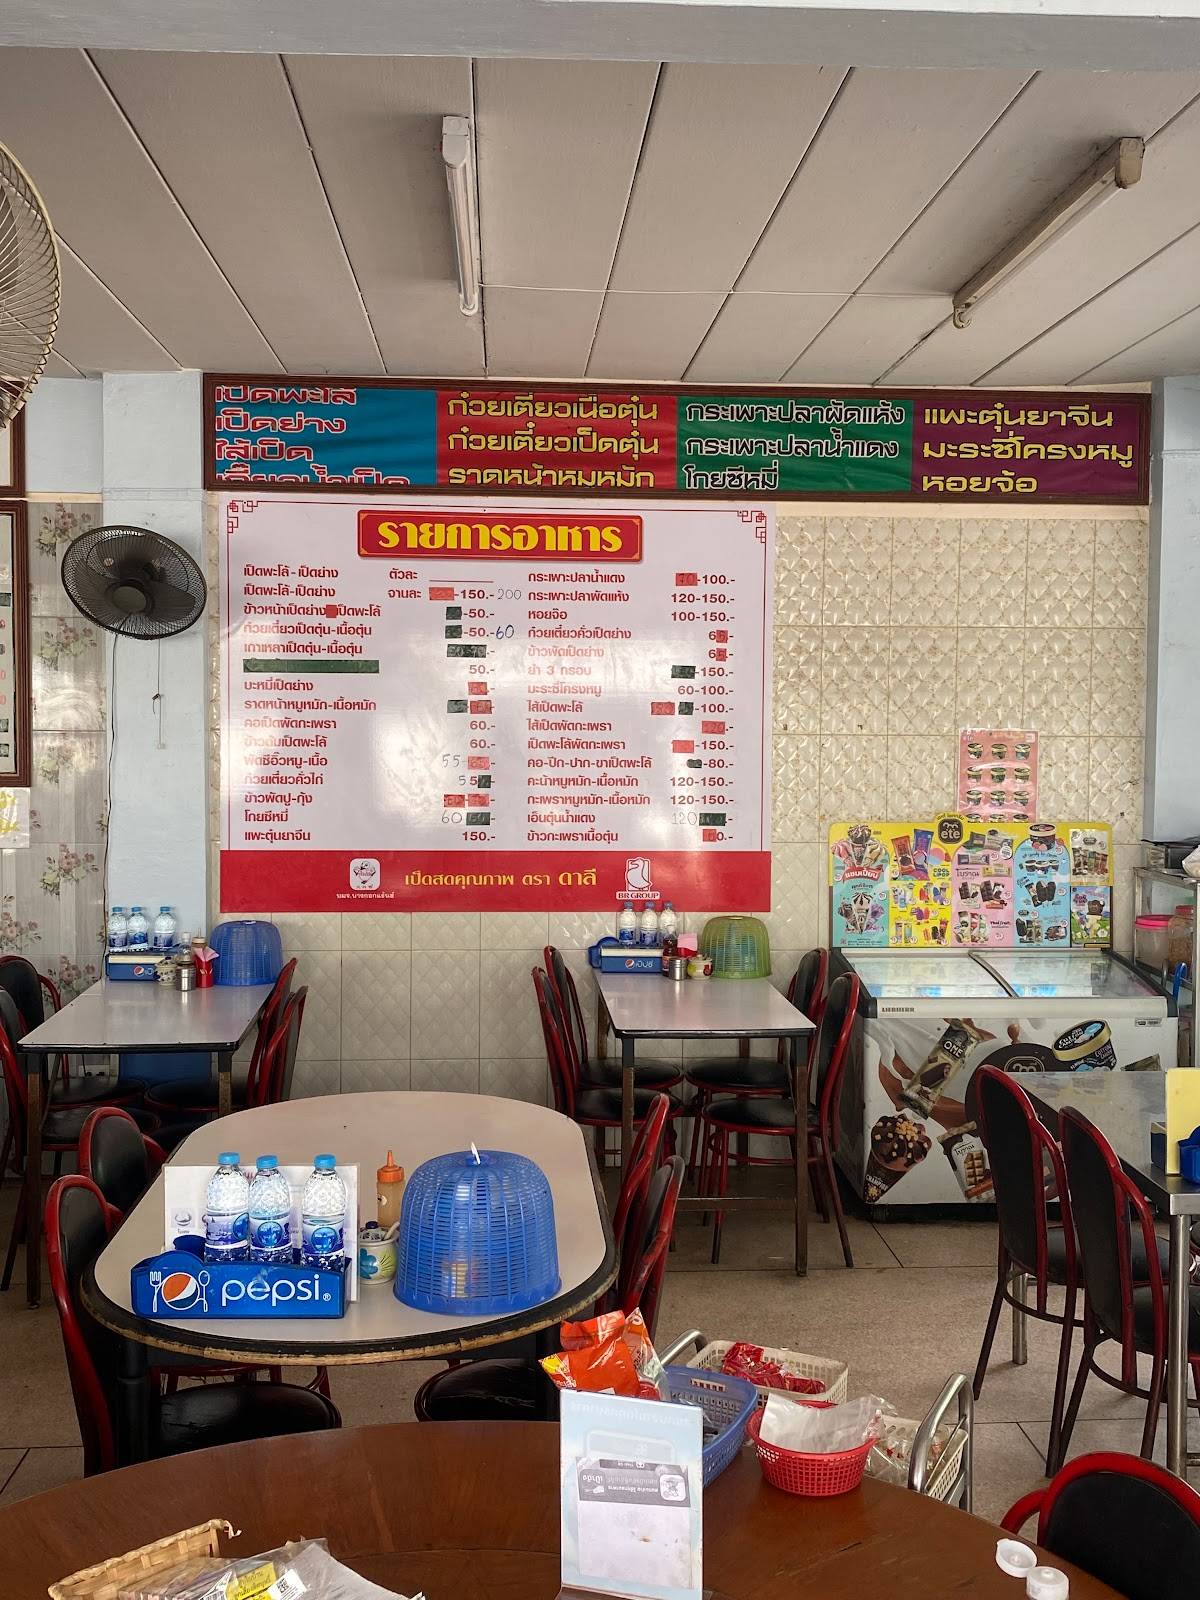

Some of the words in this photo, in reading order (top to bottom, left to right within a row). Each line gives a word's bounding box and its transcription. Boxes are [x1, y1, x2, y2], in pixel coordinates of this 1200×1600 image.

[686, 400, 906, 424] กระเพาะปลาผัดแห้ง
[924, 402, 1114, 433] แพะตุ๋นยาจีน
[216, 408, 347, 433] เป็ดย่าง
[447, 421, 660, 462] ก๋วยเตี๋ยวเป็ดตุ๋น
[686, 427, 900, 458] กระเพาะปลาน้ำแดง
[683, 460, 779, 490] โกยซีหมี่
[922, 469, 1038, 493] หอยจ้อ
[378, 520, 623, 553] รายการอาหาร
[389, 567, 418, 580] ตัวละ
[387, 588, 422, 600] จานละ
[671, 592, 735, 603] 120-150.-
[671, 611, 735, 622] 100-150.-
[469, 664, 495, 675] 50.-
[678, 685, 734, 695] 60-100.-
[470, 720, 496, 731] 60.-
[470, 738, 496, 749] 60.-
[670, 777, 734, 787] 120-150.-
[670, 795, 734, 805] 120-150.-
[462, 831, 496, 842] 150.-
[405, 870, 514, 890] เป็ดสดคุณภาพ
[522, 874, 551, 886] ตรา
[943, 1040, 964, 1058] ONE
[221, 1273, 320, 1308] pepsi
